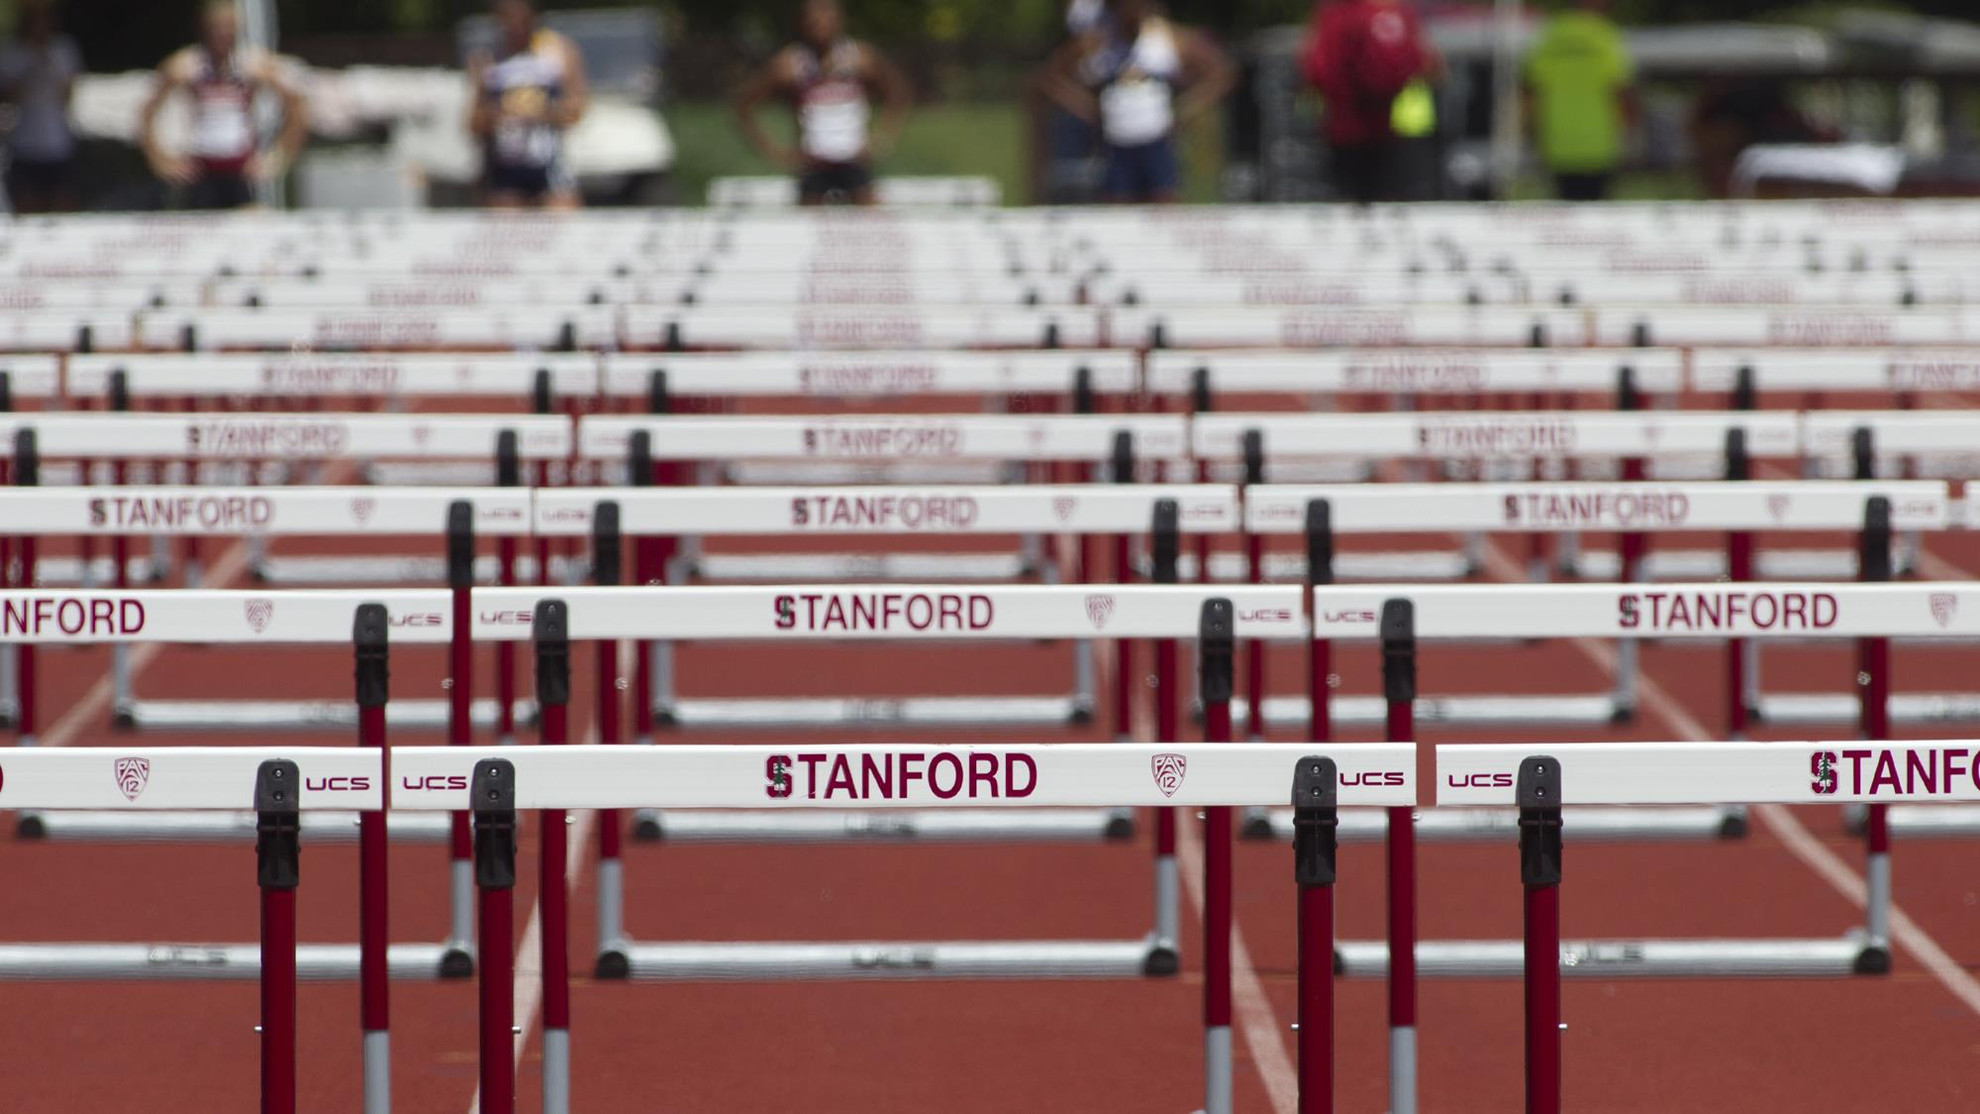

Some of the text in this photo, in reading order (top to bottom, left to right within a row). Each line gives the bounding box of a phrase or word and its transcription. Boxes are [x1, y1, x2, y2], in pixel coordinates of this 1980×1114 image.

[88, 496, 273, 526] STANFORD
[791, 496, 978, 528] STANFORD
[1505, 493, 1689, 524] STANFORD
[0, 598, 145, 635] NFORD
[774, 594, 994, 632] STANFORD
[1617, 592, 1838, 629] STANFORD
[126, 780, 139, 792] 12
[306, 777, 370, 791] UCS
[403, 776, 467, 790] UCS
[765, 752, 1038, 799] STANFORD
[1163, 776, 1176, 788] 12
[1340, 772, 1404, 786] UCS
[1449, 774, 1513, 787] UCS
[1810, 749, 1980, 796] STANF
